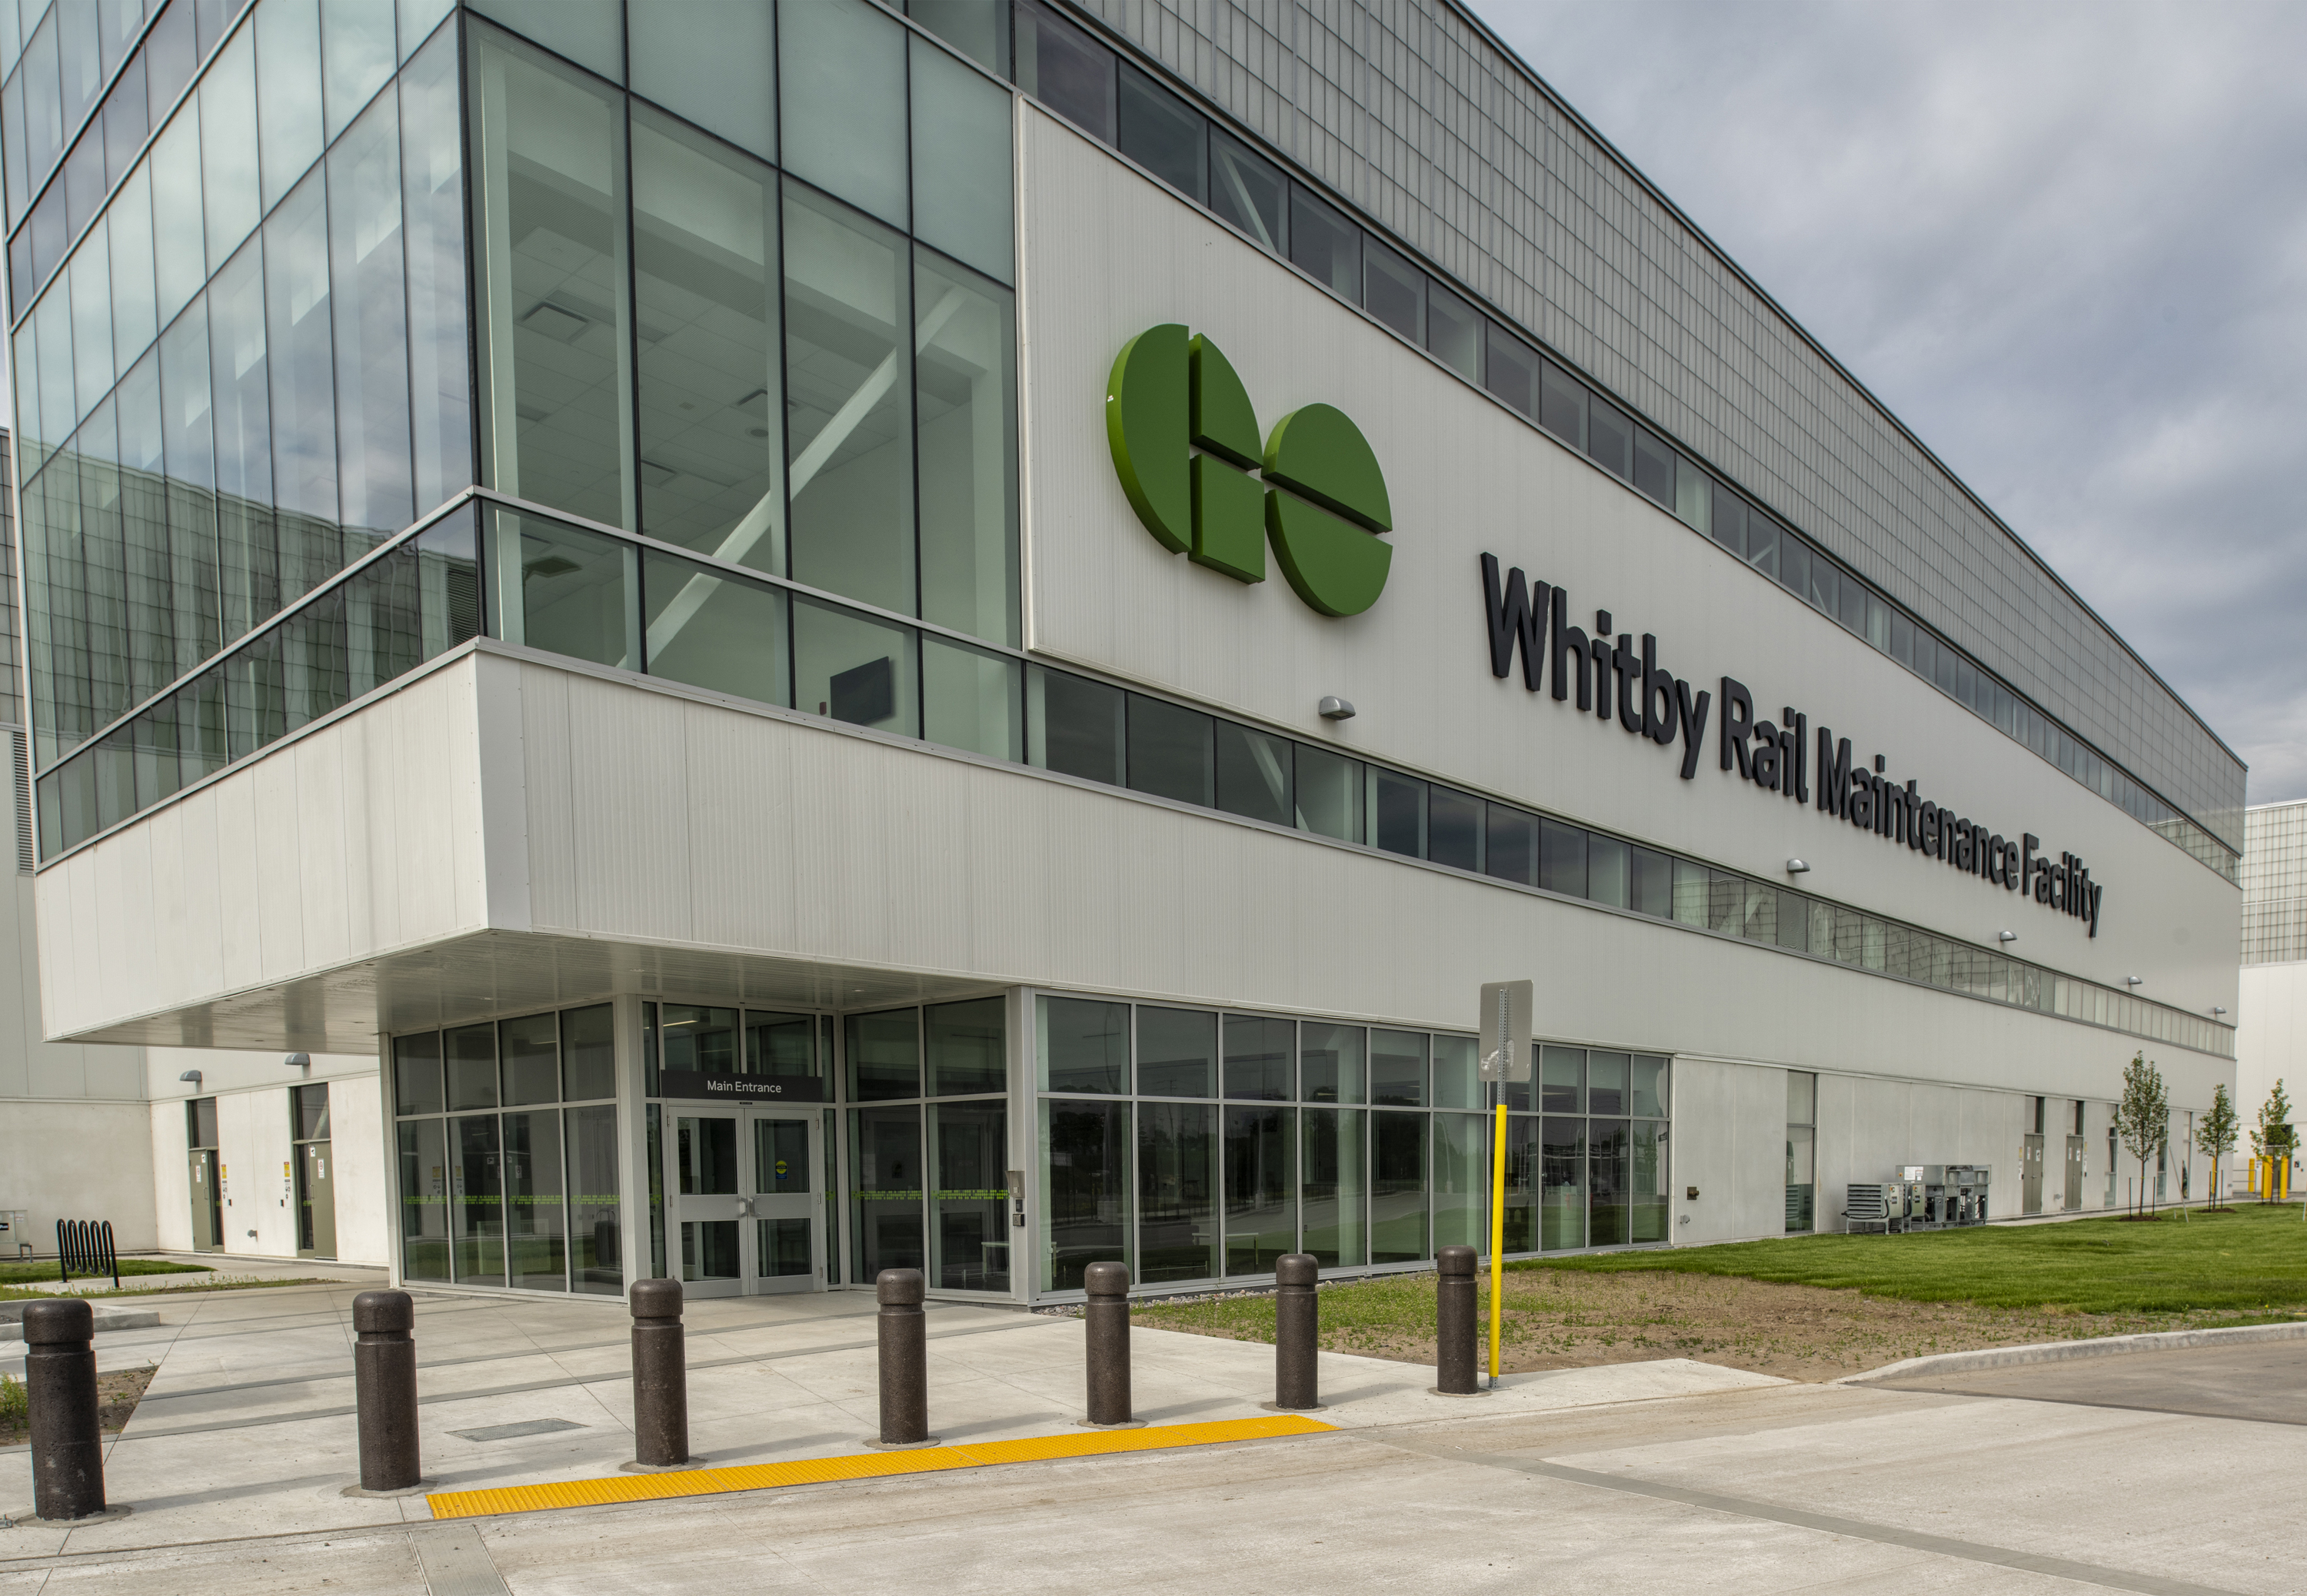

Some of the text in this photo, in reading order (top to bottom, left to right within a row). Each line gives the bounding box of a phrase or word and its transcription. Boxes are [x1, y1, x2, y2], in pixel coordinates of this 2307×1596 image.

[1480, 551, 2102, 938] Whitby Rail Maintenance Facility
[707, 1080, 781, 1092] Main Entrance
